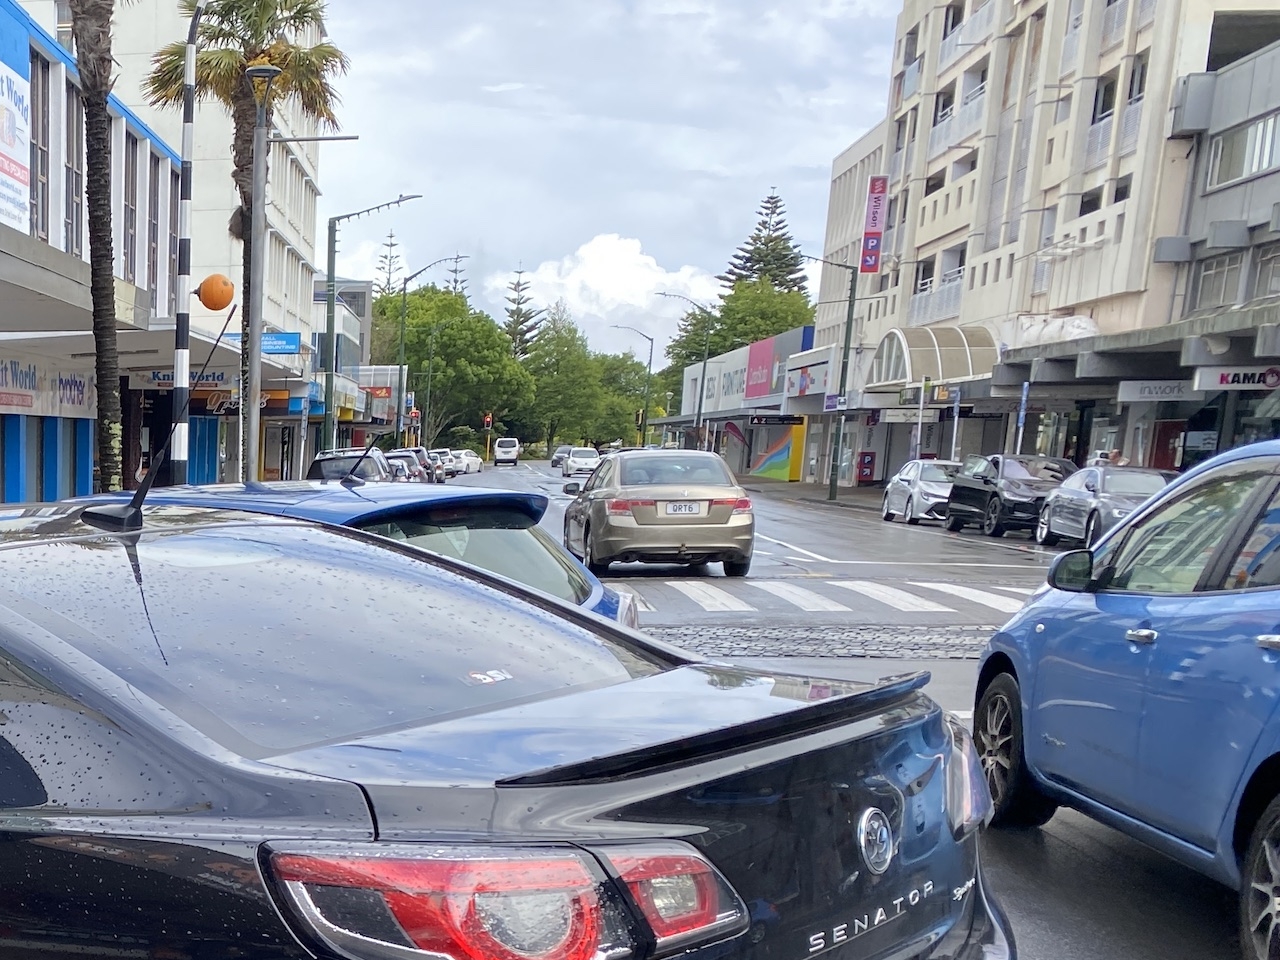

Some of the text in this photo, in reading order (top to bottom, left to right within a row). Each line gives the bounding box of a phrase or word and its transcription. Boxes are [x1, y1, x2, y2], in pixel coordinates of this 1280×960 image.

[6, 75, 29, 126] World
[871, 195, 881, 227] Wilson
[868, 239, 878, 249] P
[10, 360, 37, 391] World
[152, 371, 175, 381] Kni
[1220, 372, 1266, 384] KAMA
[808, 880, 934, 952] SENATOR
